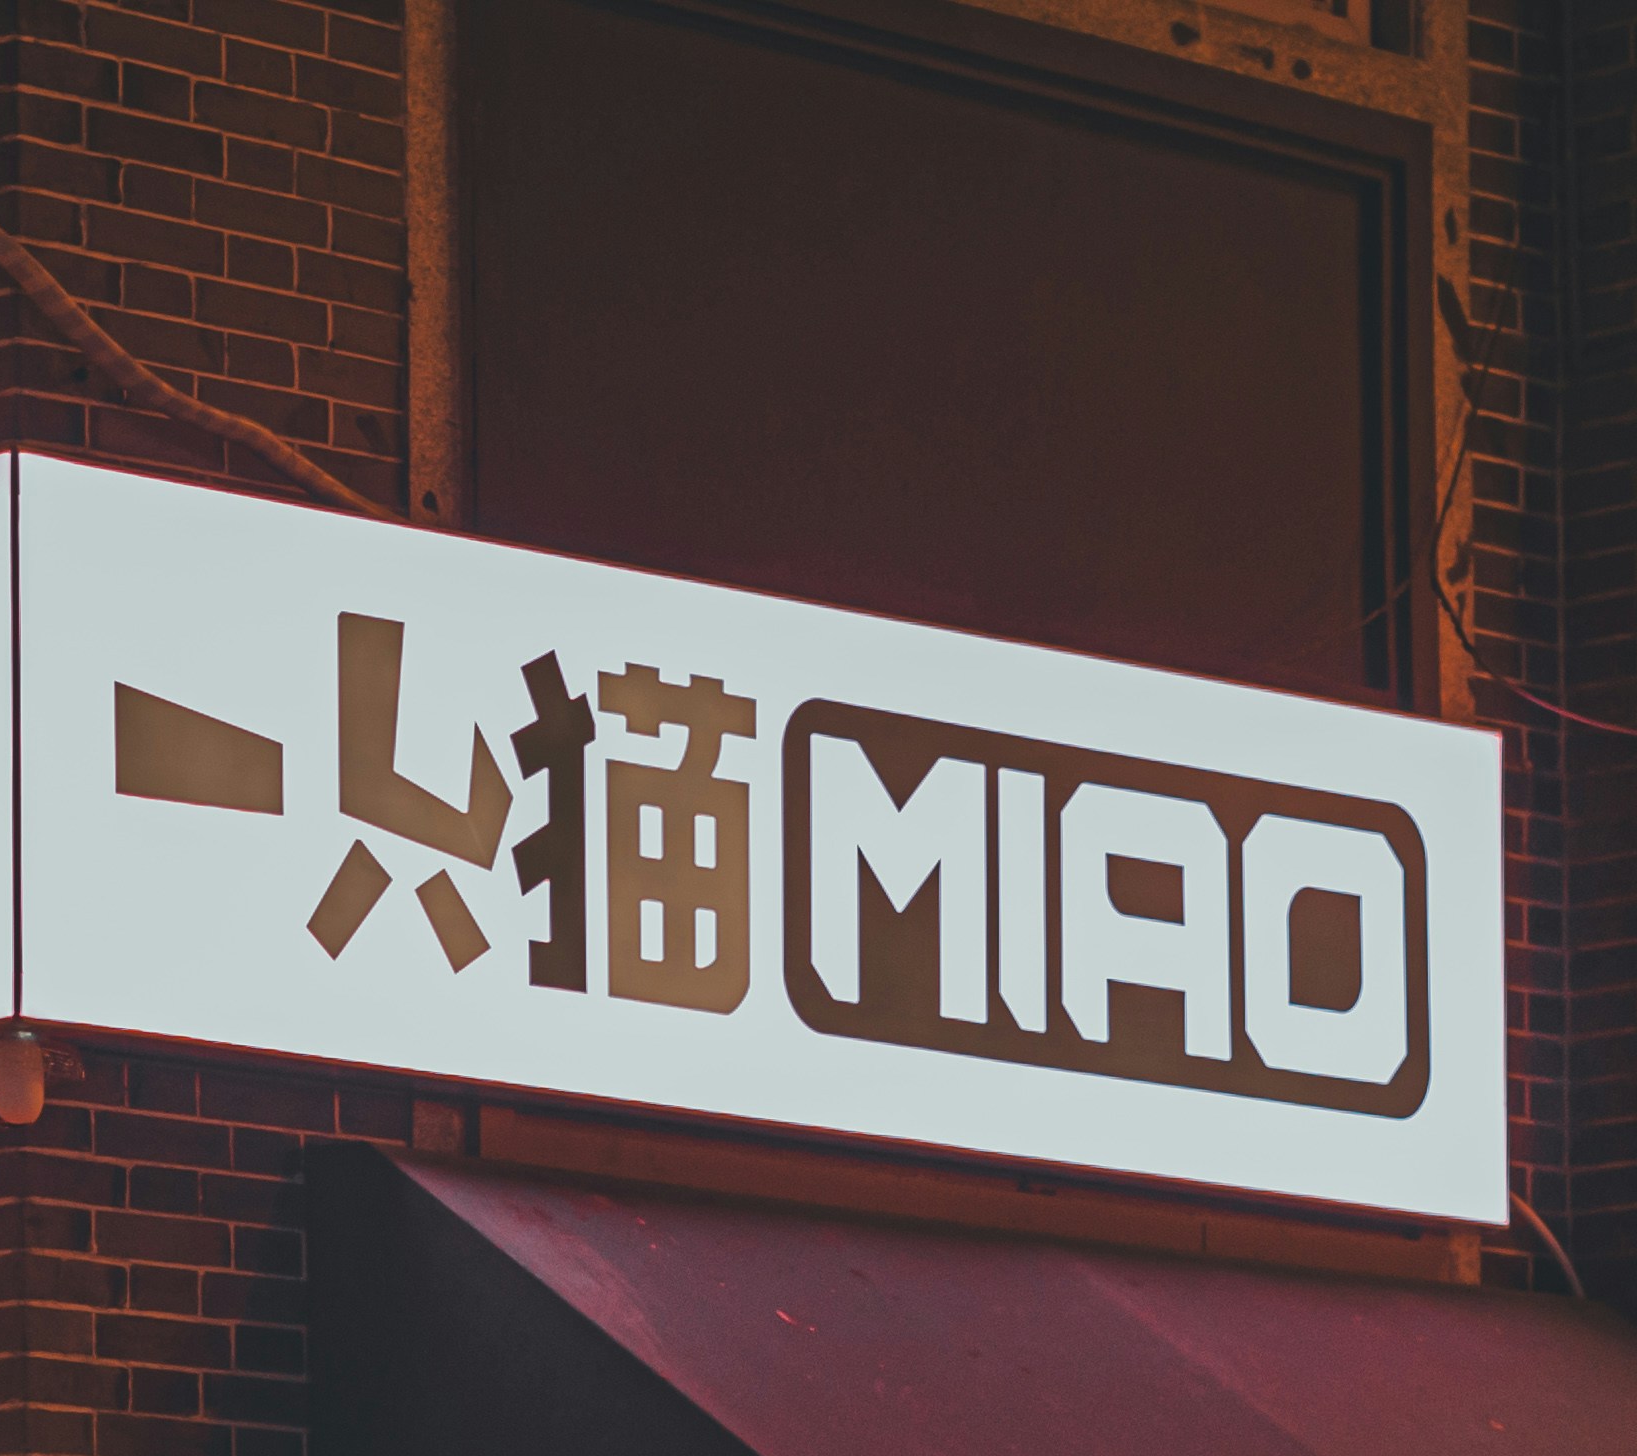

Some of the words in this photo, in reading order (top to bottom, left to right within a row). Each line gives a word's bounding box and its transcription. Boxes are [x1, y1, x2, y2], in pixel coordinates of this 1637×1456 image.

[114, 610, 757, 1015] 一只猫
[809, 731, 1408, 1085] MIAO
